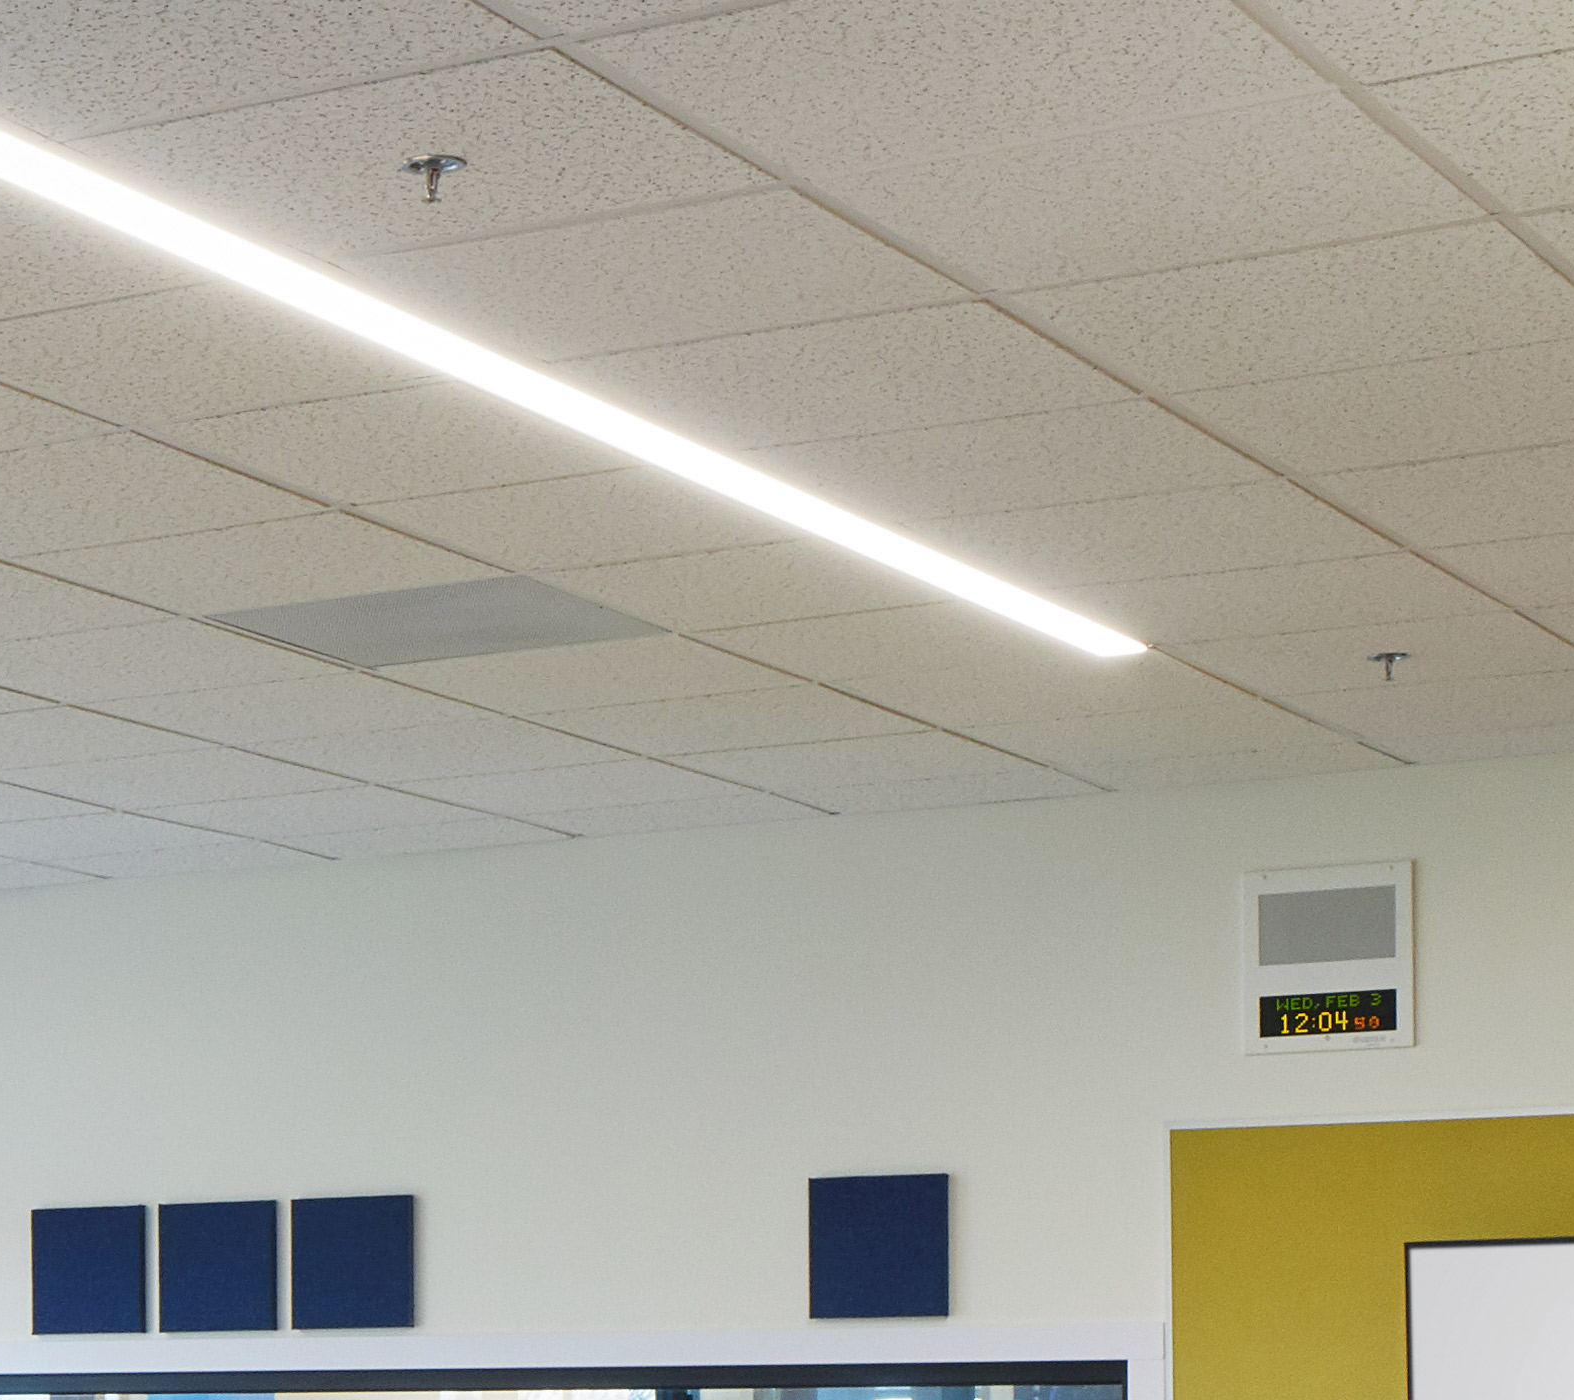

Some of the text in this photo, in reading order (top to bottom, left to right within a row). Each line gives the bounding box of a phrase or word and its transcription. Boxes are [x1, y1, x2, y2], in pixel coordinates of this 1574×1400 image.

[1325, 994, 1360, 1008] FEB
[1370, 993, 1382, 1006] 3
[1281, 1010, 1348, 1034] 12:04
